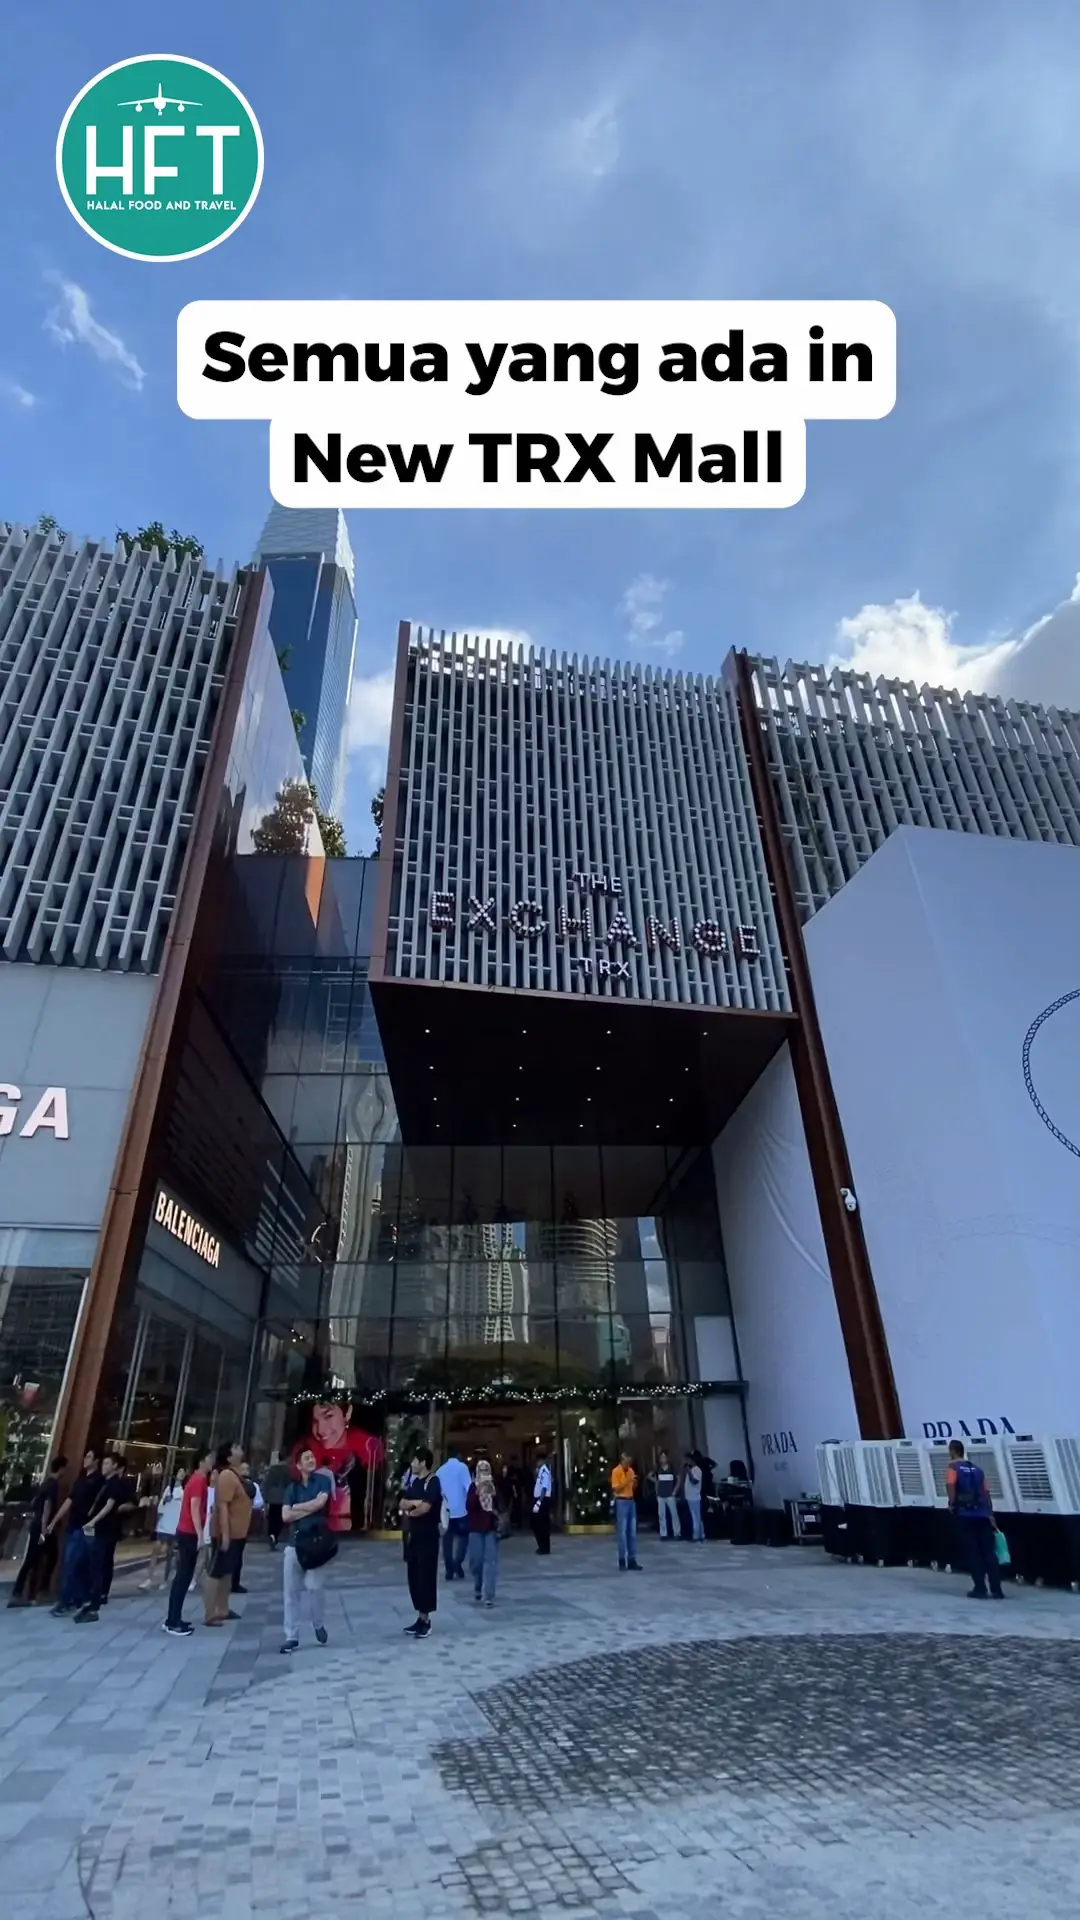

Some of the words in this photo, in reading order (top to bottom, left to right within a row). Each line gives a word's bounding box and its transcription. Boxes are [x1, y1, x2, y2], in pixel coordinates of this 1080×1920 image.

[574, 871, 622, 893] THE
[431, 890, 761, 960] EXCHANGE
[579, 956, 630, 977] TRX
[154, 1190, 221, 1269] BALENCIAGA
[761, 1431, 798, 1456] PRADA
